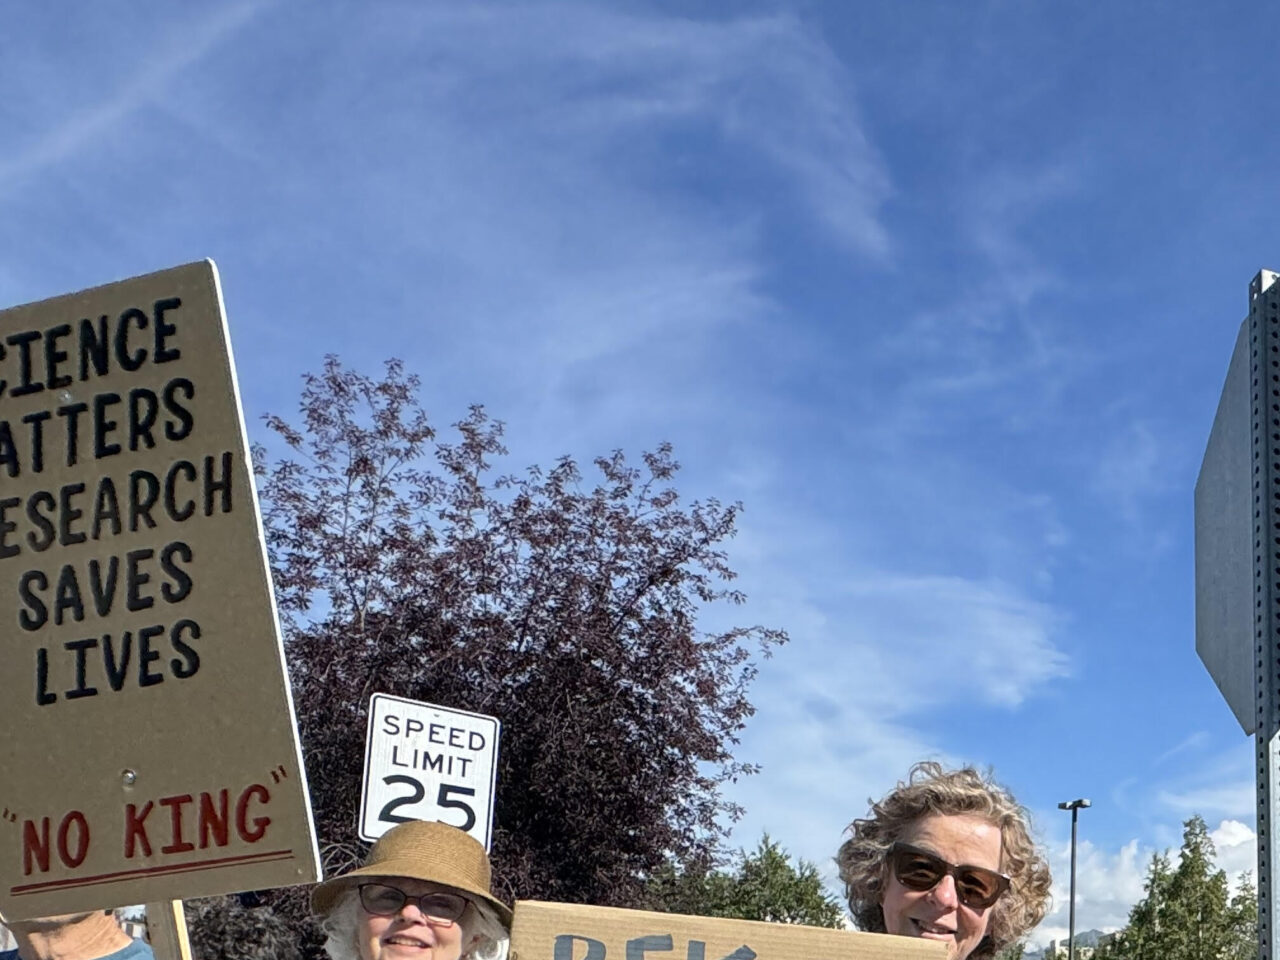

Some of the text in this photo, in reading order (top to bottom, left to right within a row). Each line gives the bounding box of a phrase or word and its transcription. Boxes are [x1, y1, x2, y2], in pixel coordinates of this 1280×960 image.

[0, 297, 182, 398] IENCE
[18, 540, 194, 632] SAVES
[35, 618, 202, 706] LIVES
[382, 714, 486, 751] SPEED
[392, 745, 474, 778] LIMIT
[378, 774, 476, 832] 25
